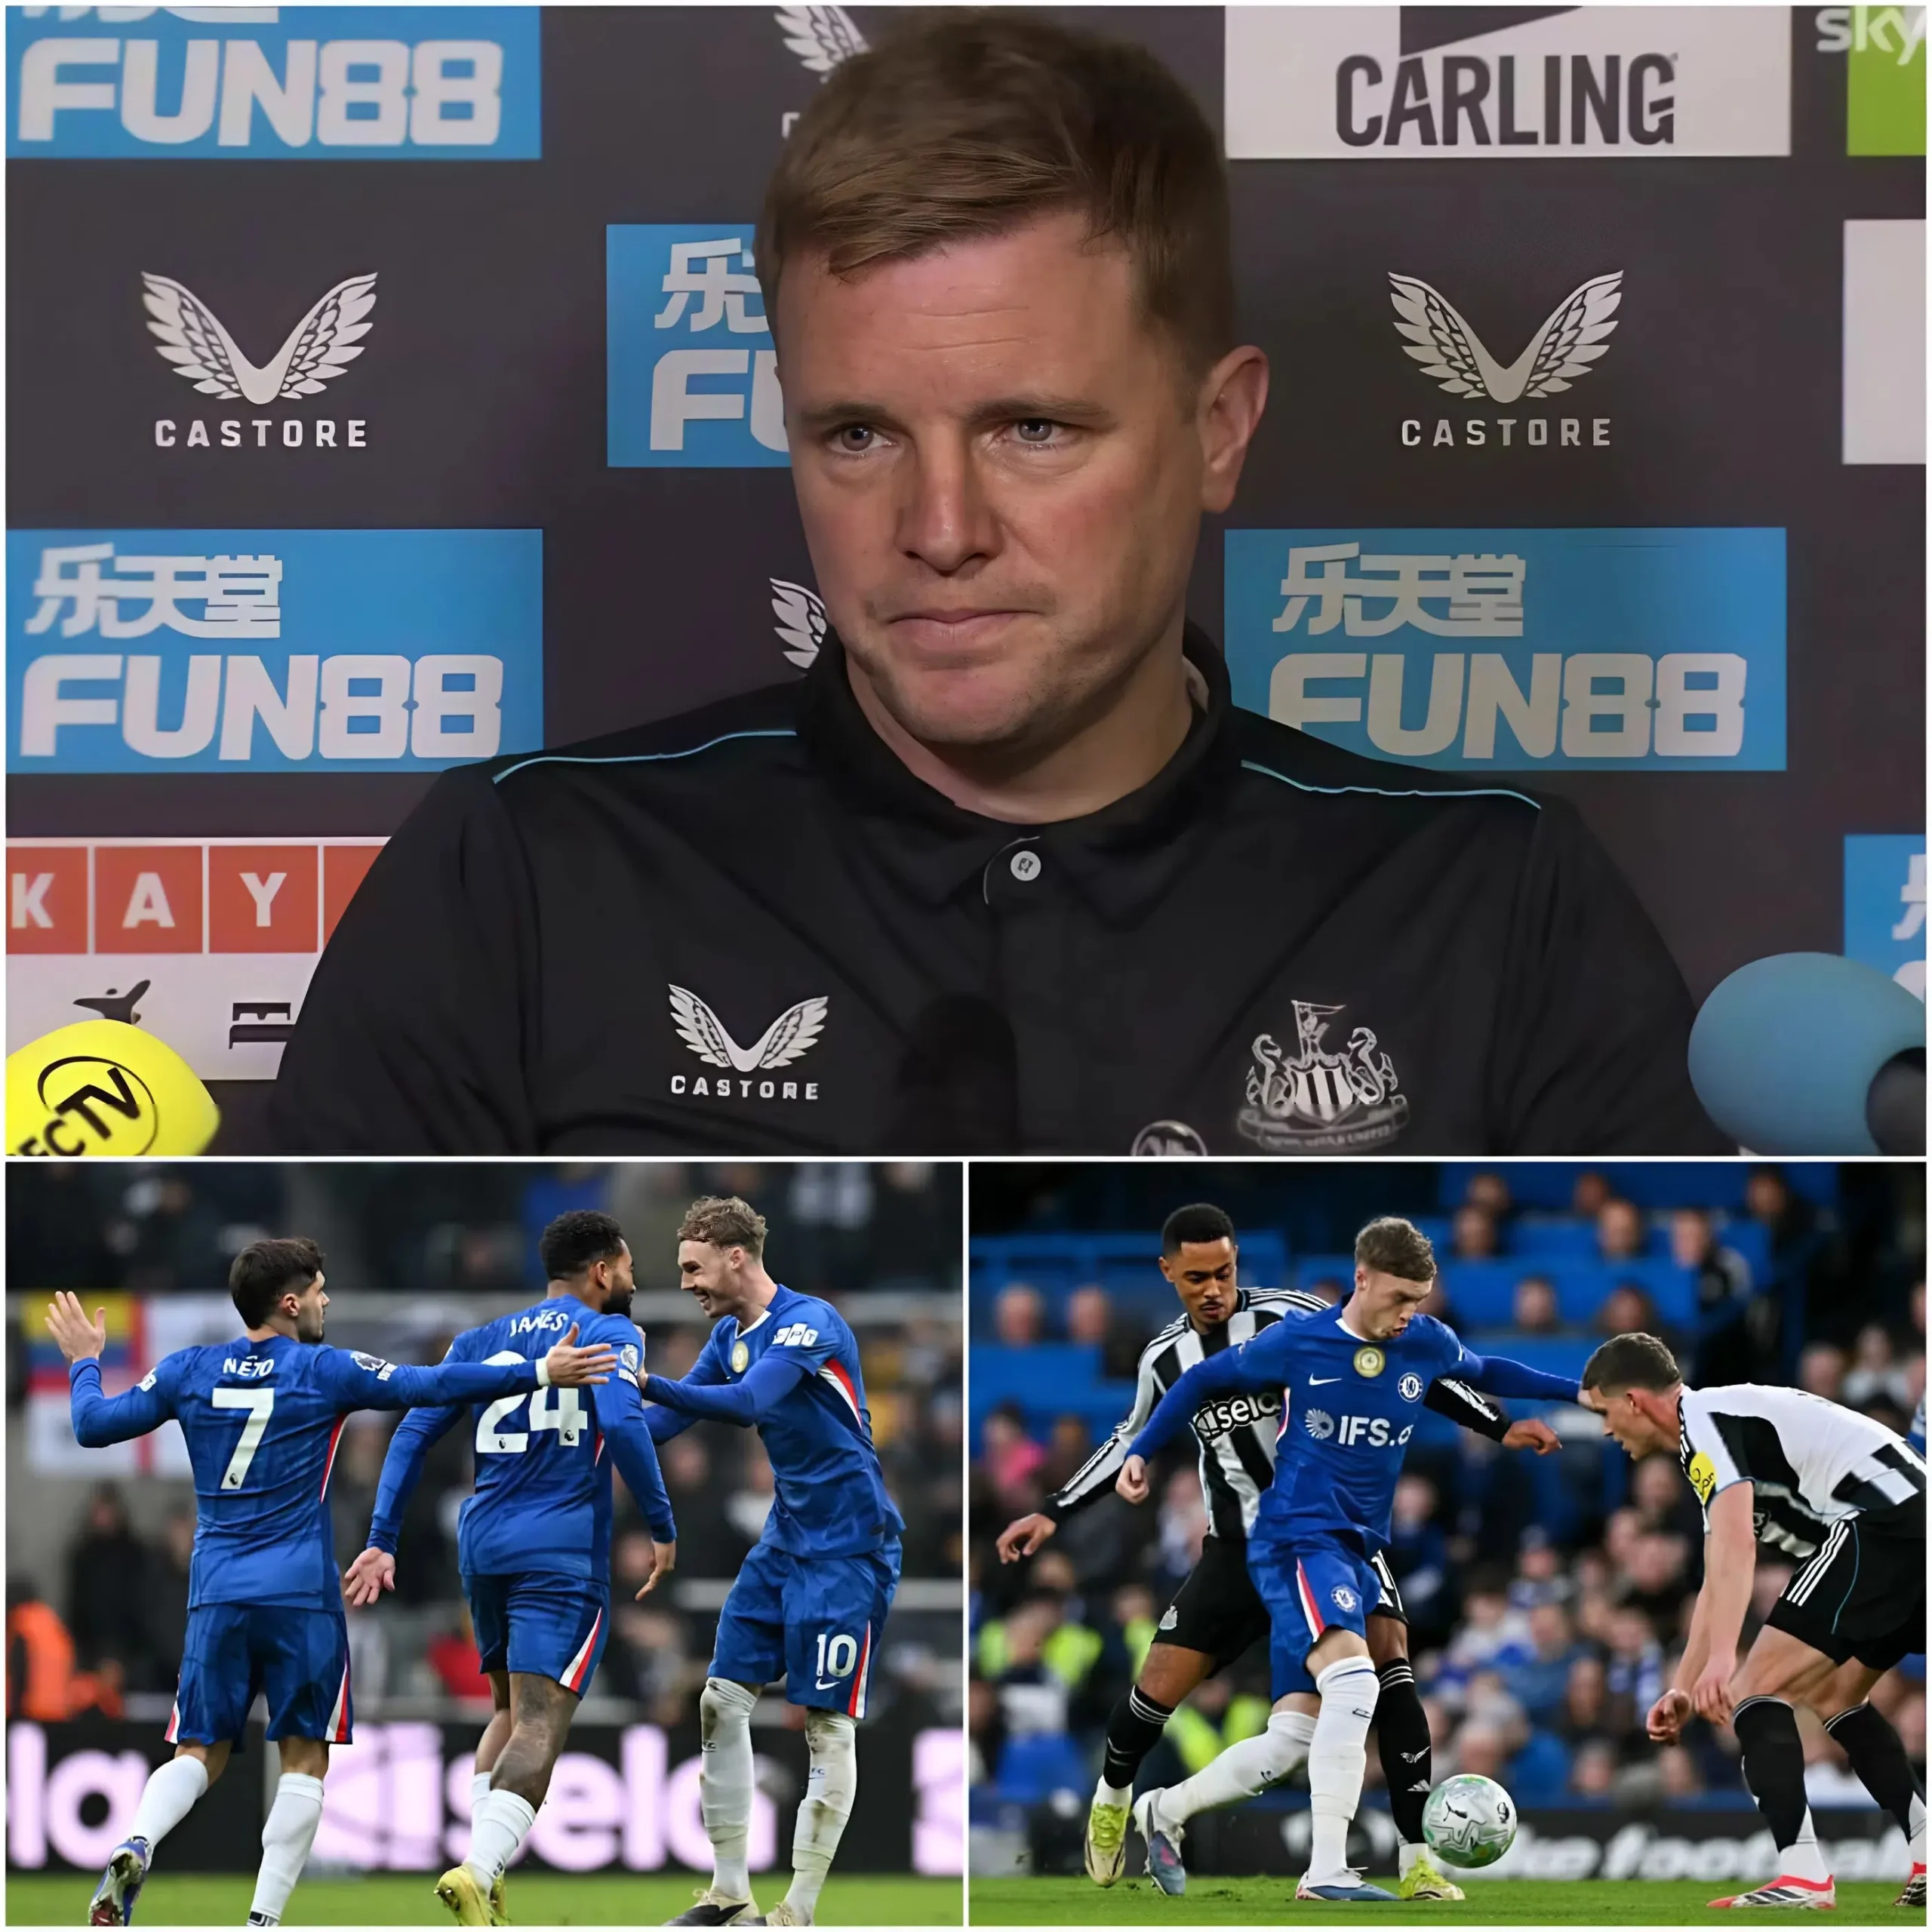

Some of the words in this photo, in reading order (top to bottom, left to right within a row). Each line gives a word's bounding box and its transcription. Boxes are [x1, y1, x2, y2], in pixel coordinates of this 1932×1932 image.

[1815, 6, 1926, 66] sky
[18, 38, 503, 148] FUN88
[1335, 53, 1675, 146] CARLING
[155, 419, 367, 448] CASTORE
[1401, 418, 1611, 447] CASTORE
[25, 543, 283, 638] 乐天堂
[1272, 543, 1526, 637] 乐天堂
[20, 654, 504, 760] FUN88
[1269, 653, 1747, 759] FUN88
[670, 1075, 819, 1100] CASTORE
[223, 1357, 275, 1378] NETO
[475, 1350, 588, 1454] 24
[212, 1388, 275, 1490] 7
[817, 1634, 857, 1678] 10
